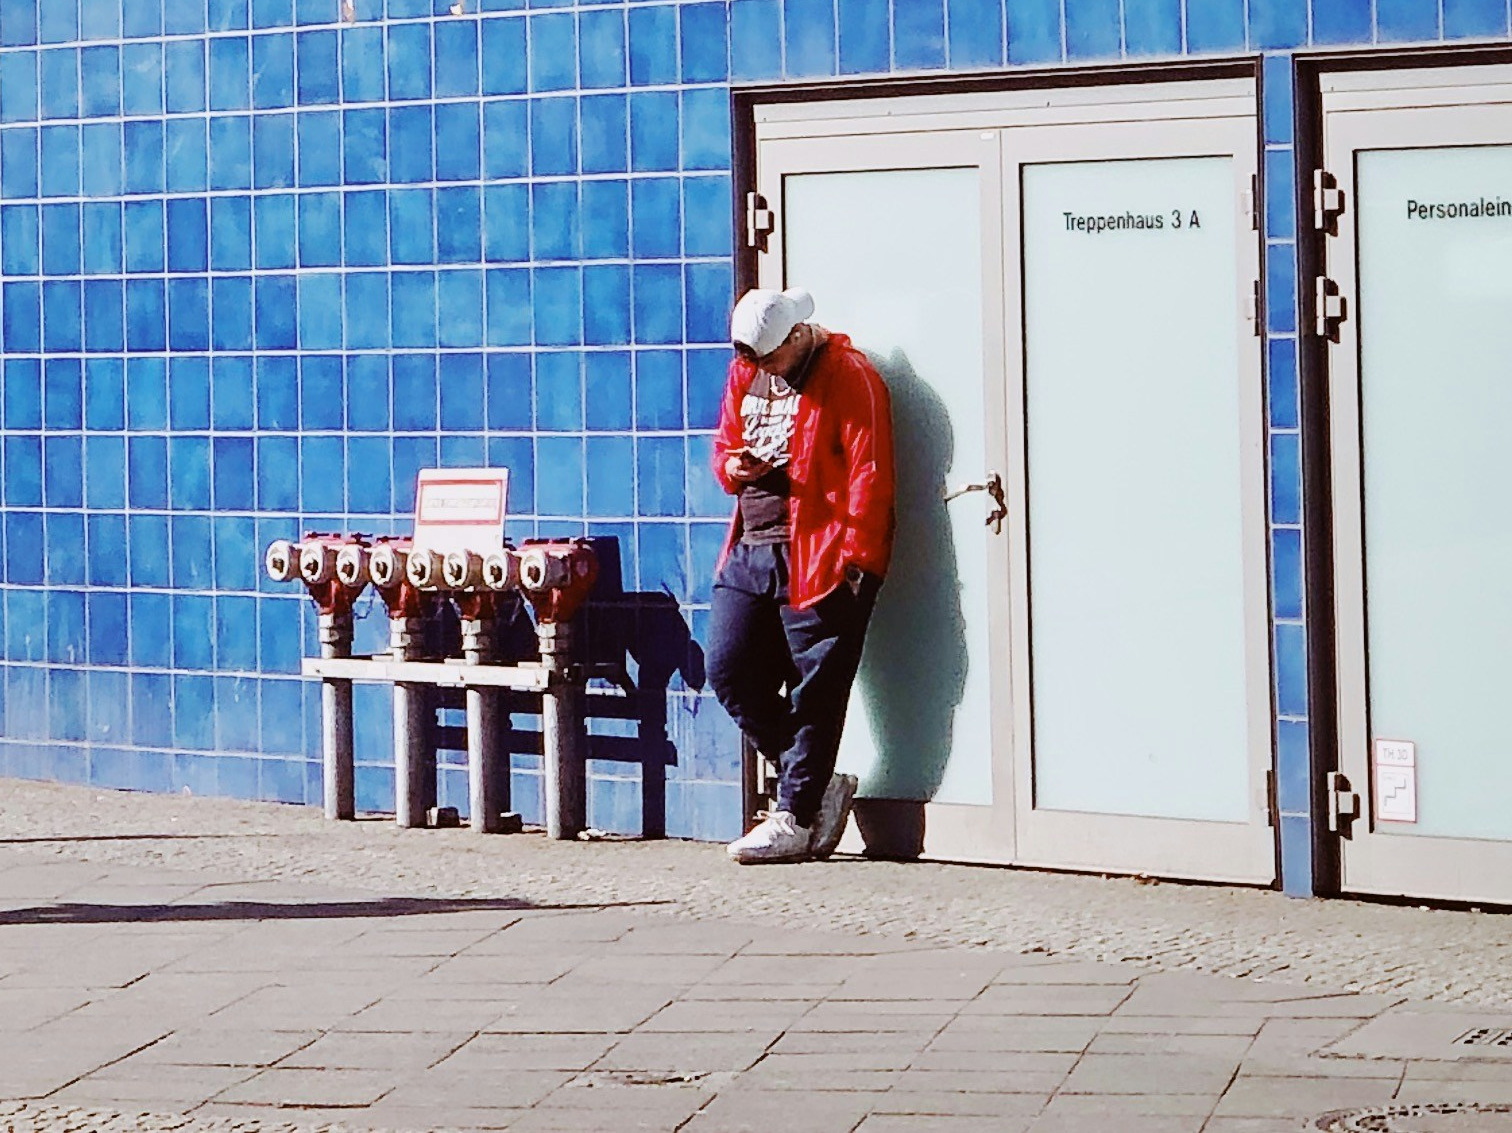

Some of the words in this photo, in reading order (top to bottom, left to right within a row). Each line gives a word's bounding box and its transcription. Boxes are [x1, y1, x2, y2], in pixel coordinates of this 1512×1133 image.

[1407, 195, 1512, 220] Personalein
[1062, 210, 1164, 234] Treppenhaus
[1171, 209, 1182, 229] 3
[1188, 209, 1201, 229] A
